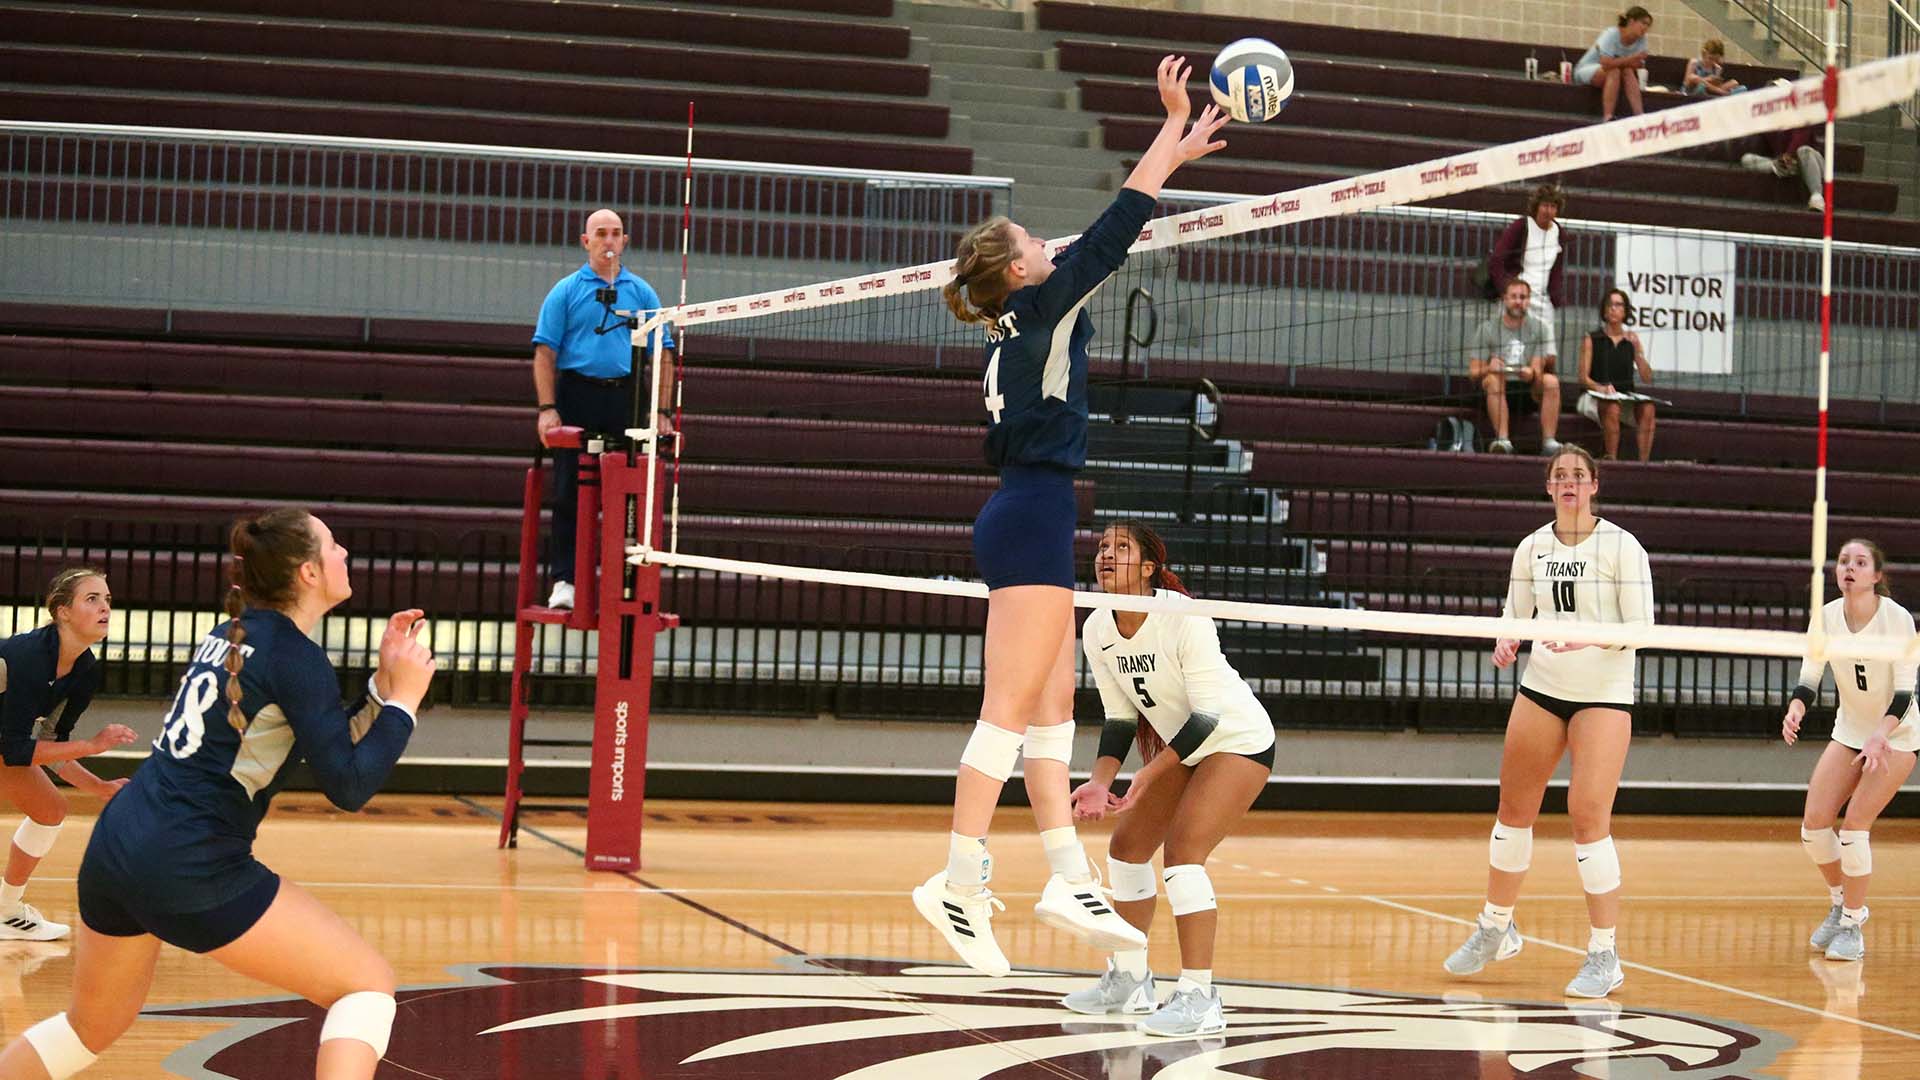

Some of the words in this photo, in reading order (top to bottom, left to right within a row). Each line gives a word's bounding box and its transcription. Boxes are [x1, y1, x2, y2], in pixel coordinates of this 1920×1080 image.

[1628, 272, 1722, 298] VISITOR
[1625, 307, 1726, 332] SECTION
[983, 346, 1006, 424] 4
[1544, 561, 1587, 577] TRANSY
[1552, 581, 1576, 612] 10
[1116, 653, 1156, 674] TRANSY
[1855, 664, 1868, 691] 6
[1133, 677, 1157, 708] 5
[152, 666, 218, 759] 18
[614, 701, 628, 745] sports
[611, 747, 625, 801] imports
